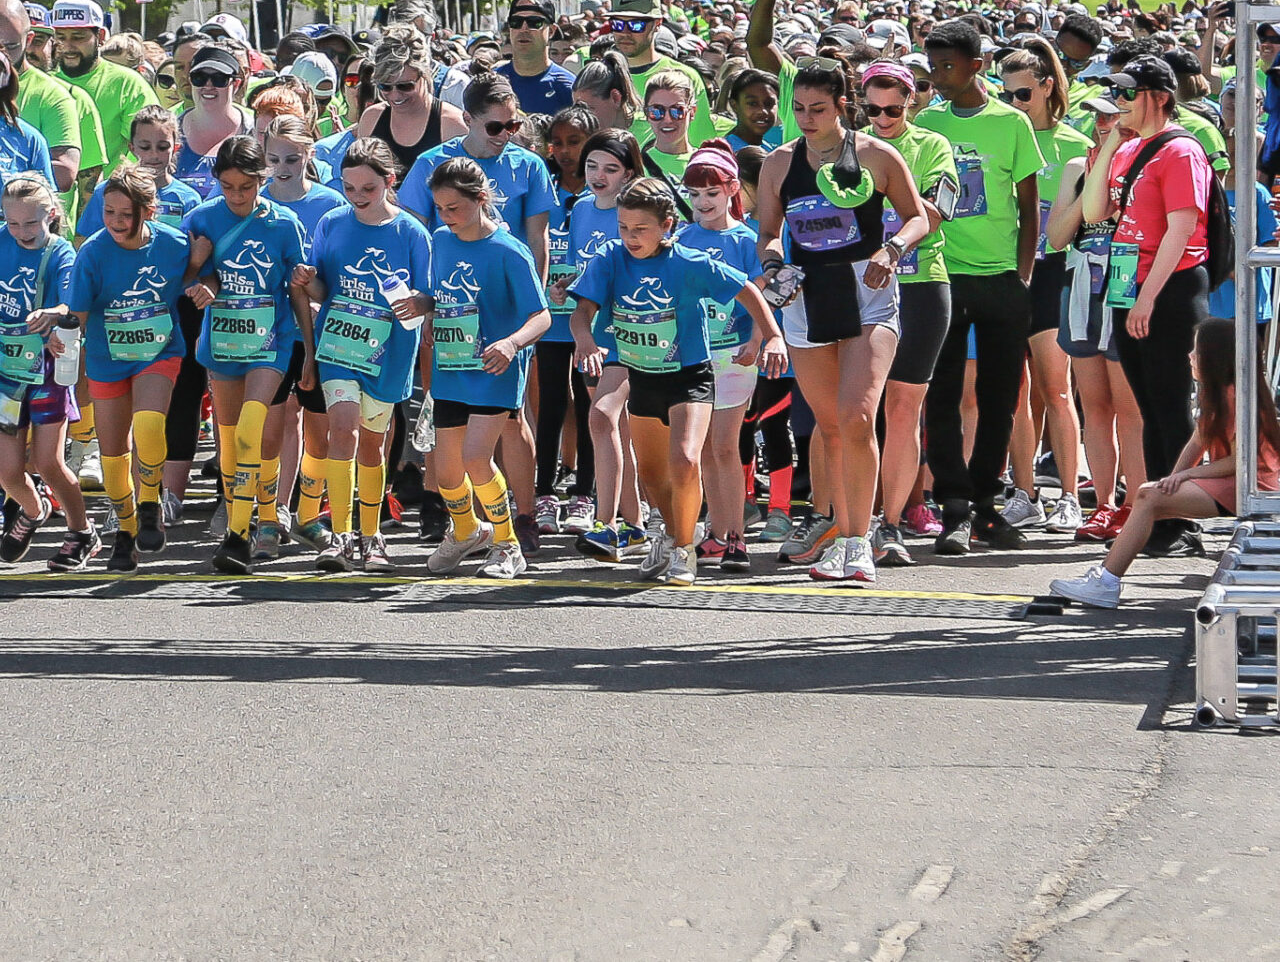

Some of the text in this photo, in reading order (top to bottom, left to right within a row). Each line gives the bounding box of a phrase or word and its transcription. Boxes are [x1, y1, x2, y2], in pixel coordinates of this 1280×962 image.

[228, 282, 255, 295] run
[348, 287, 375, 303] run
[212, 316, 256, 335] 22869
[324, 317, 371, 344] 22864
[108, 327, 155, 345] 22865
[613, 325, 658, 348] 22919
